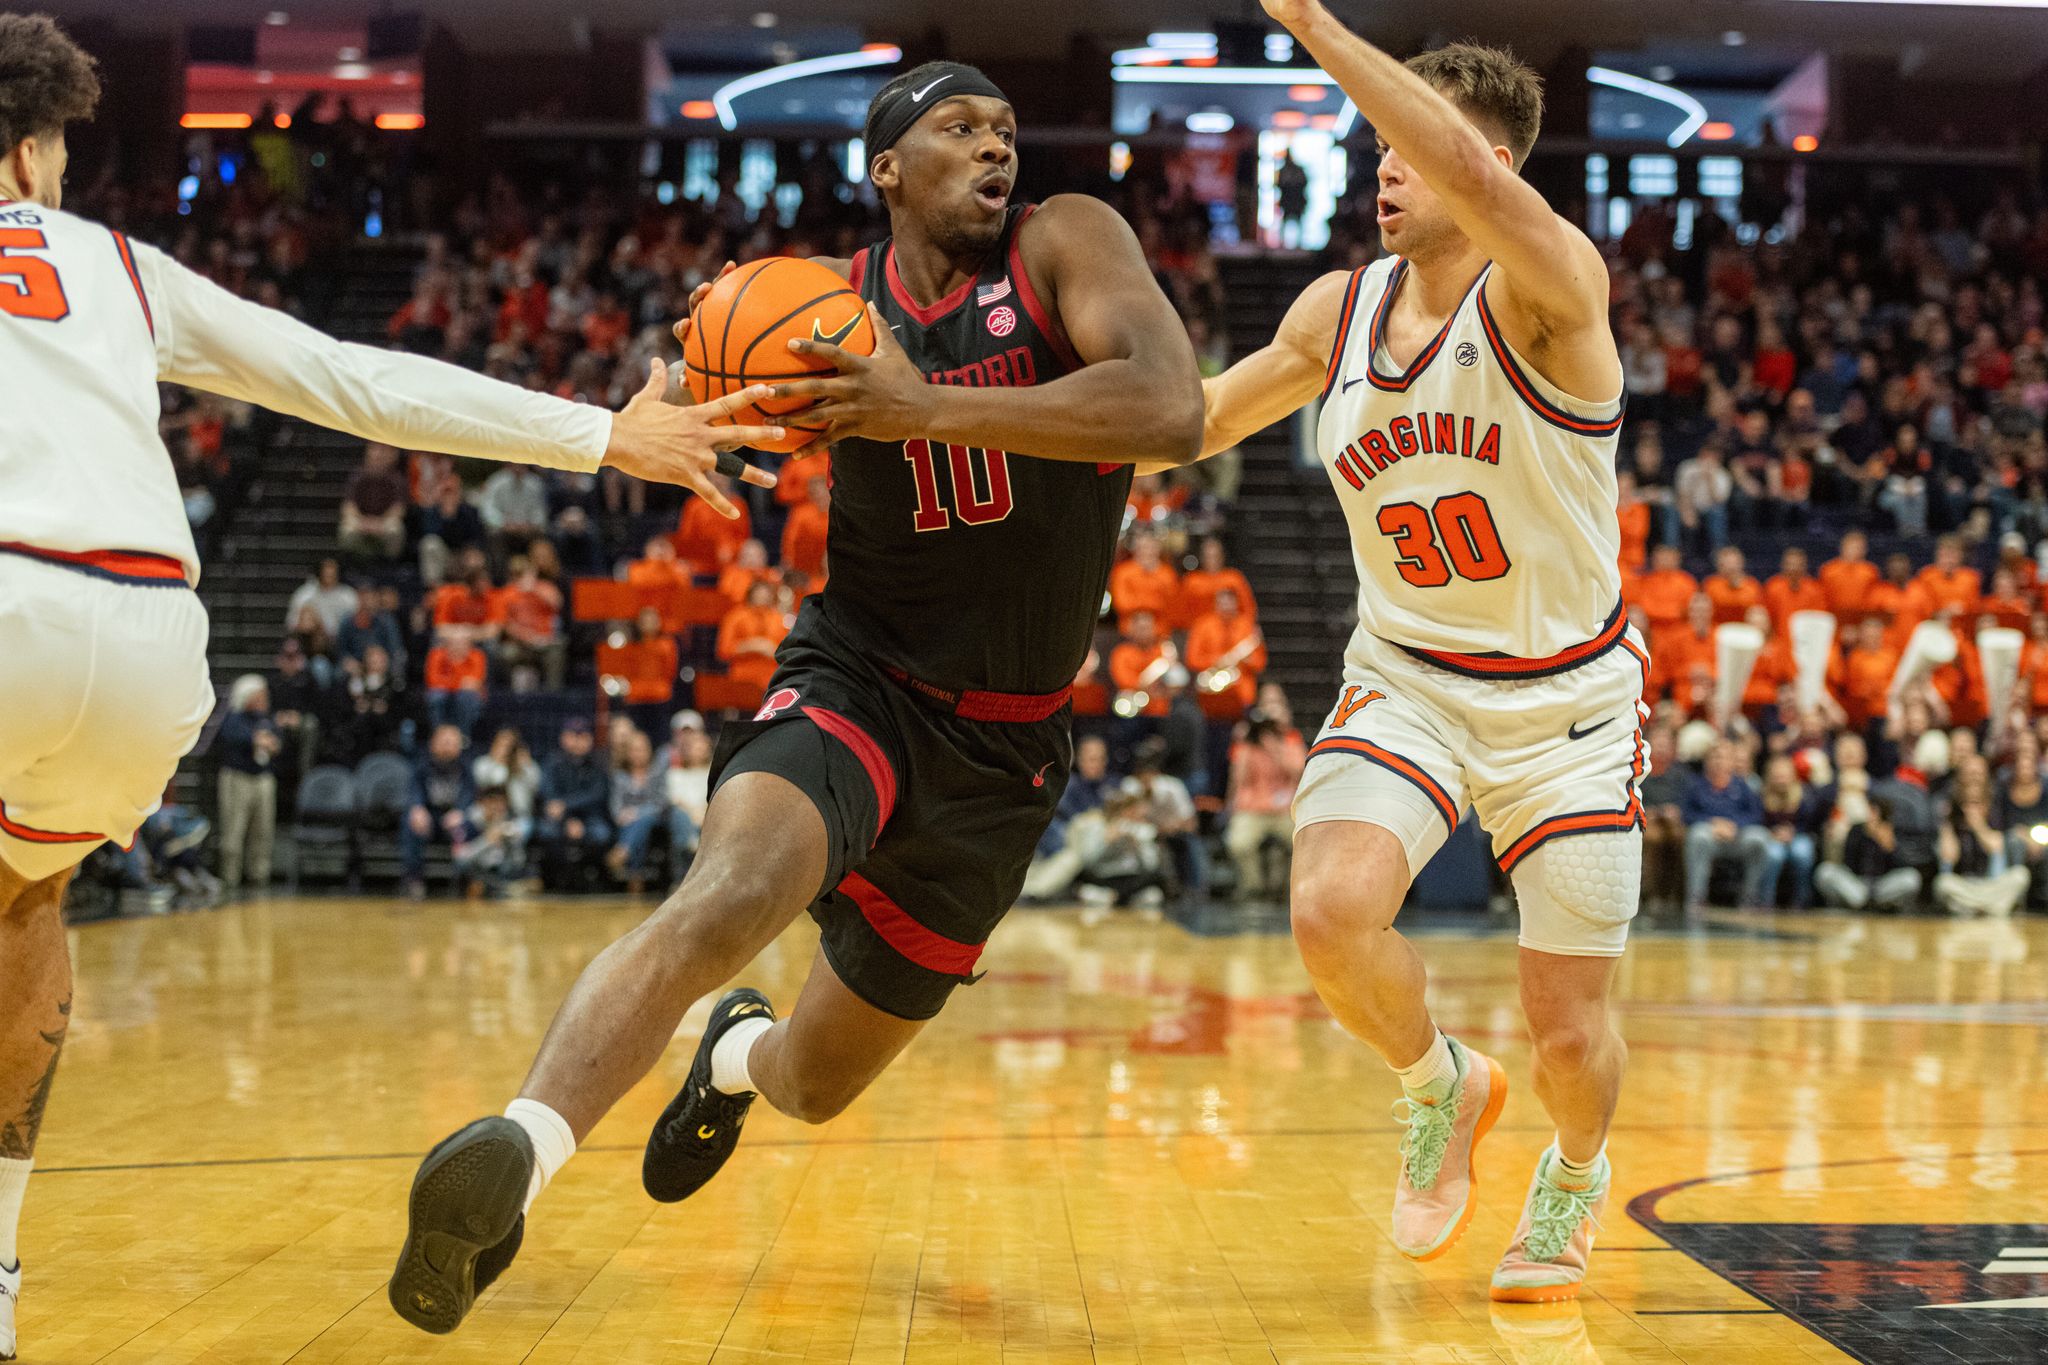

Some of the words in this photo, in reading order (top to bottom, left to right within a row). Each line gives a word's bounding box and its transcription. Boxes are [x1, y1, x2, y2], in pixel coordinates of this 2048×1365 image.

[903, 438, 1013, 532] 10
[1335, 412, 1501, 491] VIRGINIA
[1376, 490, 1512, 588] 30
[911, 679, 956, 704] CARDINAL
